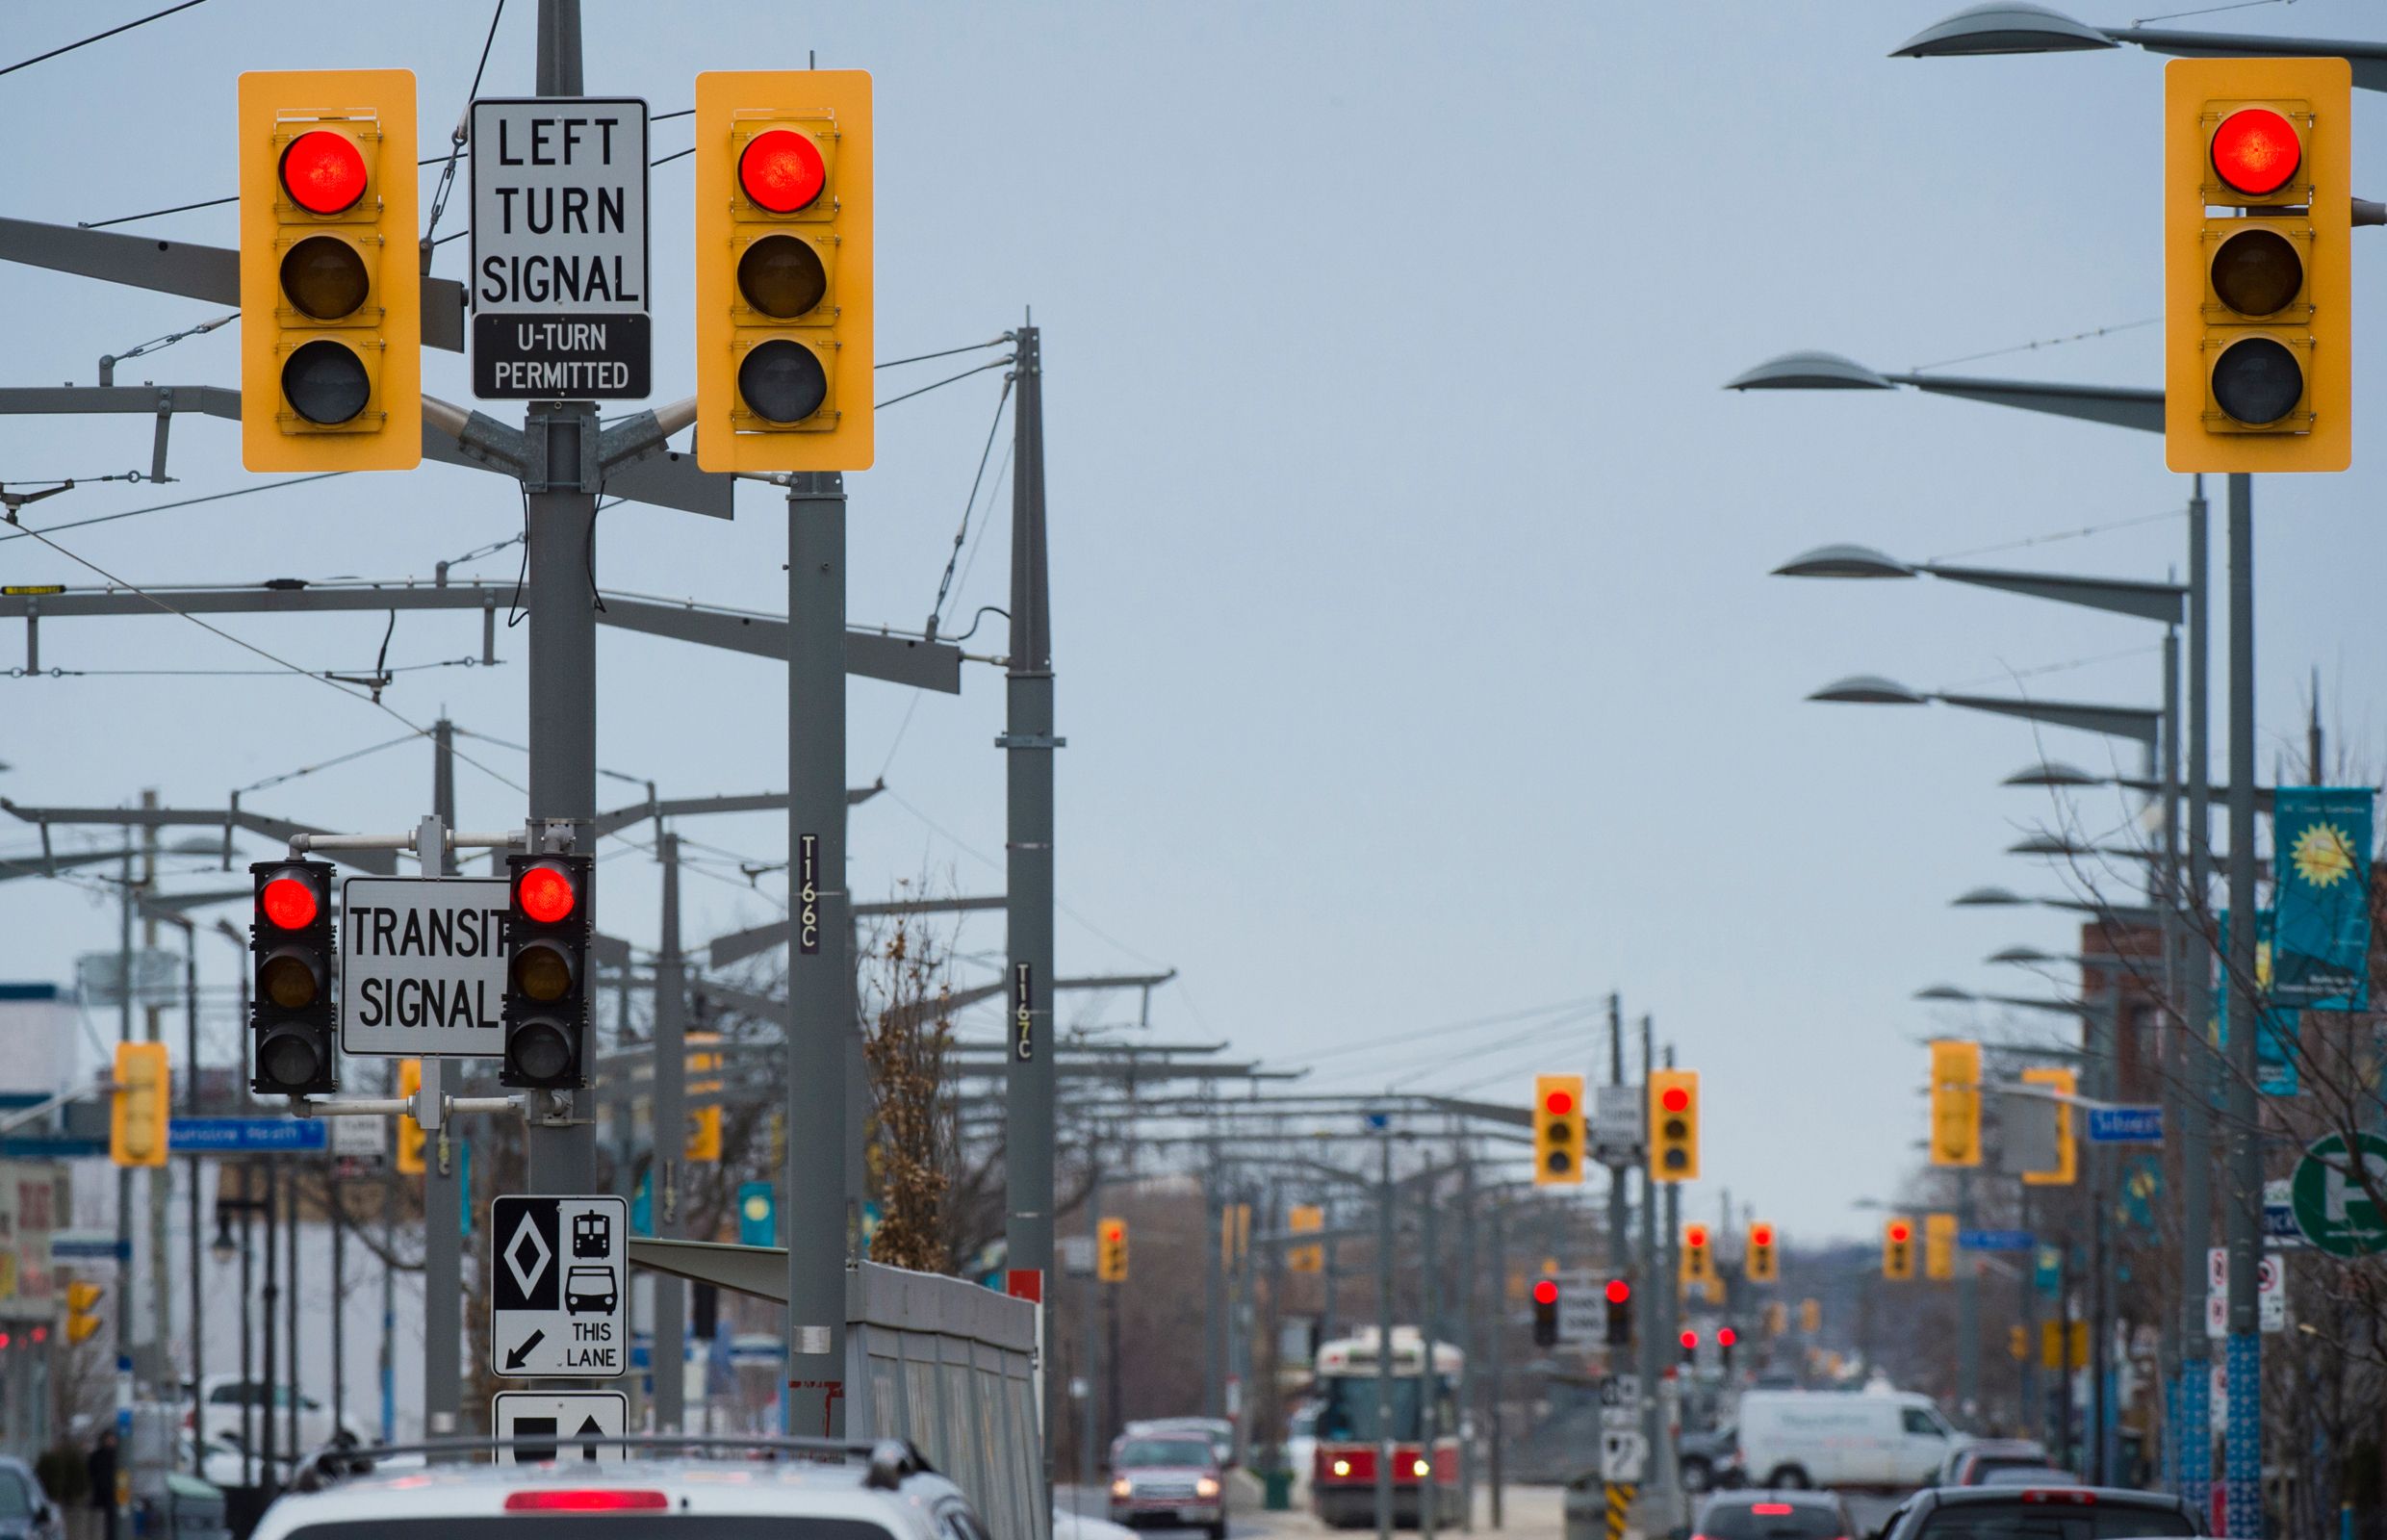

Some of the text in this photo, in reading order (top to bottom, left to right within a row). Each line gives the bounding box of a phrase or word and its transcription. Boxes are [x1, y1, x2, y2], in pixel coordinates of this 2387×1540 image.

[500, 118, 619, 166] LEFT
[495, 187, 624, 234] TURN
[481, 255, 639, 302] SIGNAL
[518, 323, 606, 351] U-TURN
[495, 362, 629, 389] PERMITTED
[802, 835, 817, 947] T166C
[349, 907, 511, 958] TRANSIT
[359, 978, 499, 1029] SIGNAL
[1017, 963, 1032, 1059] T167C
[572, 1322, 612, 1342] THIS
[567, 1348, 616, 1367] LANE
